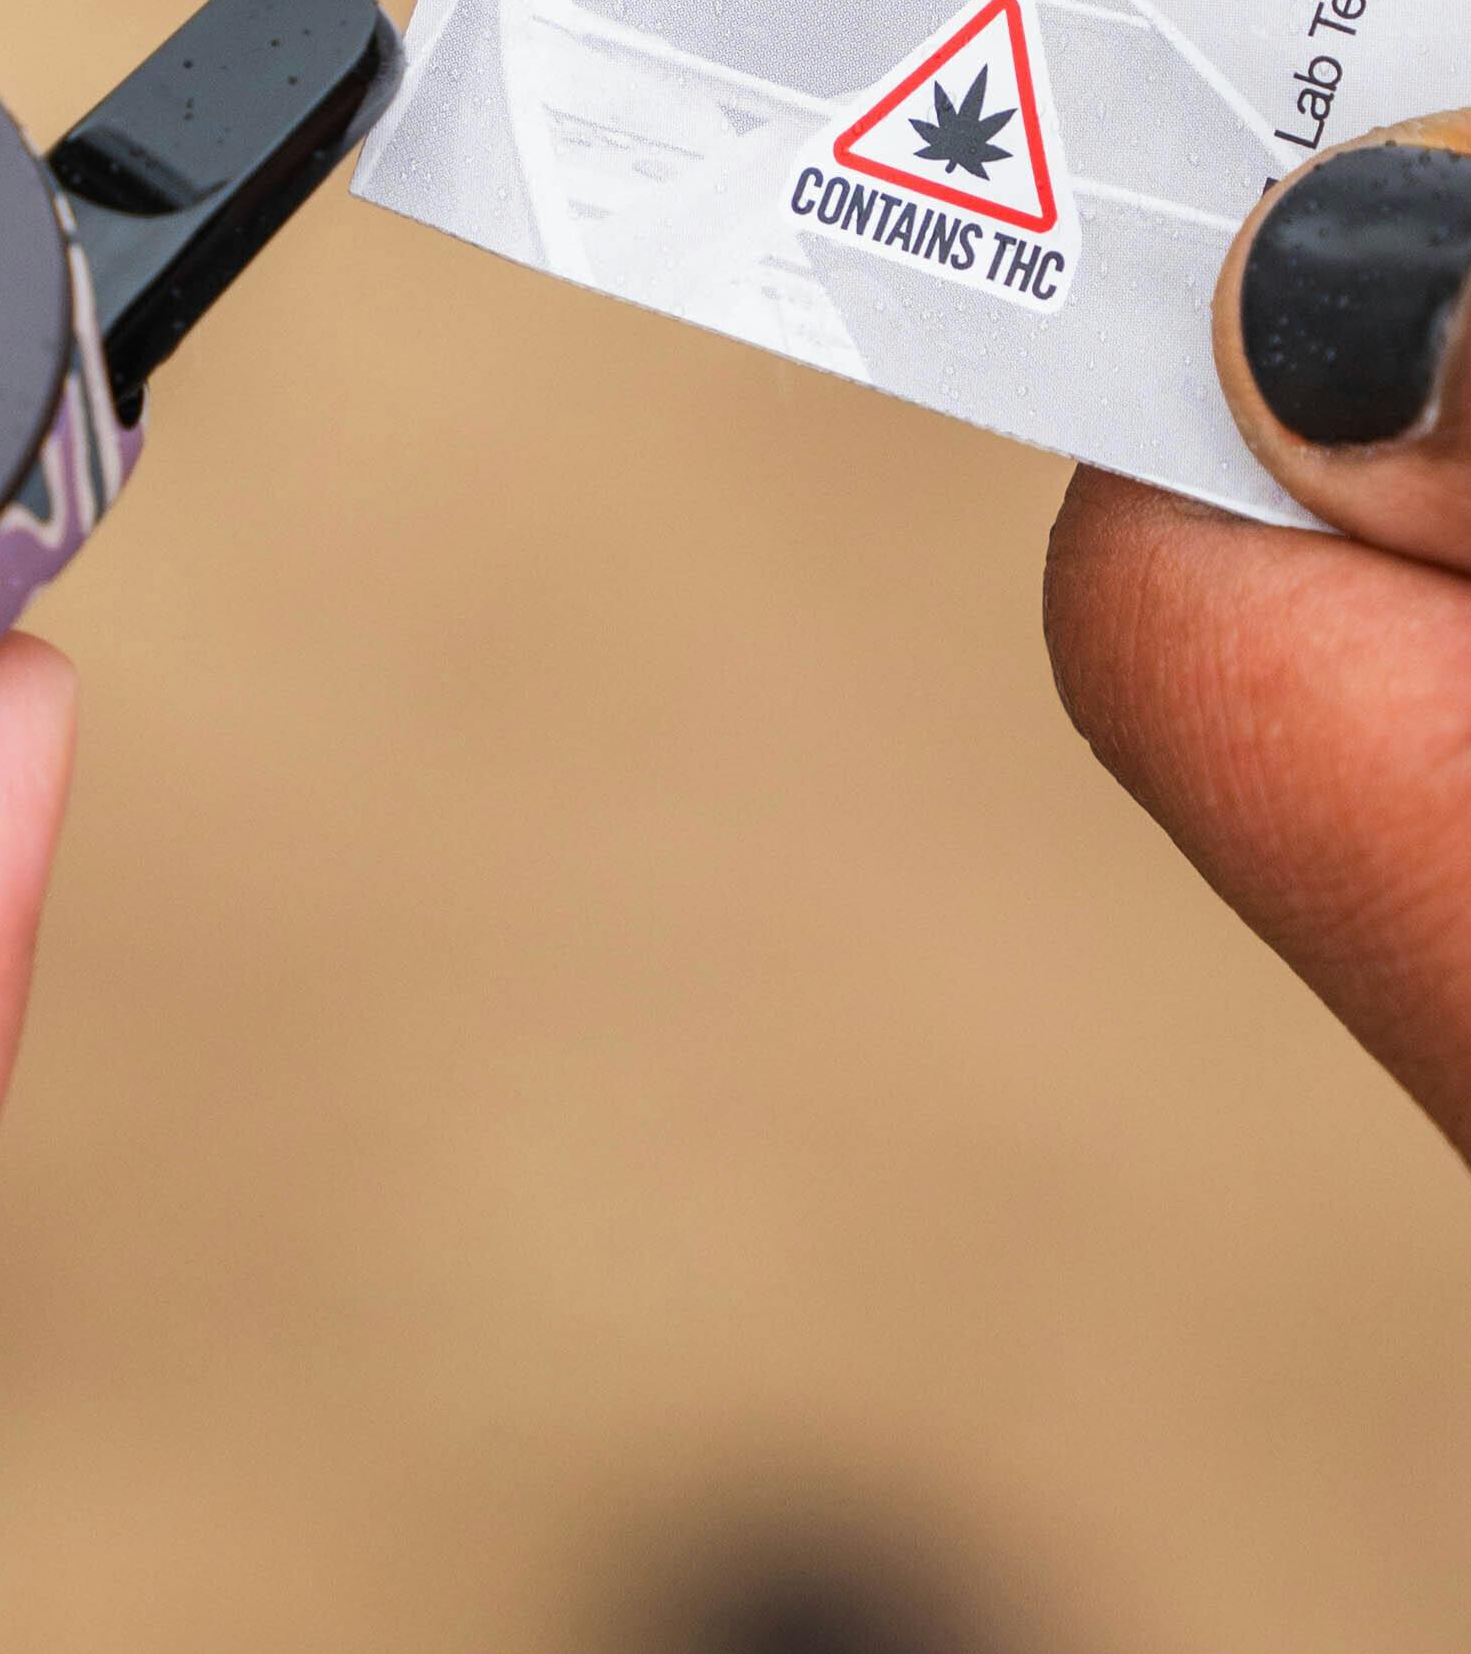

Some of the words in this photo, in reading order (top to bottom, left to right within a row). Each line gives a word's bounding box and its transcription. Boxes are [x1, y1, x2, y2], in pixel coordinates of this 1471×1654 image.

[1273, 54, 1344, 151] Lab
[790, 166, 984, 272] CONTAINS
[985, 231, 1066, 302] THC
